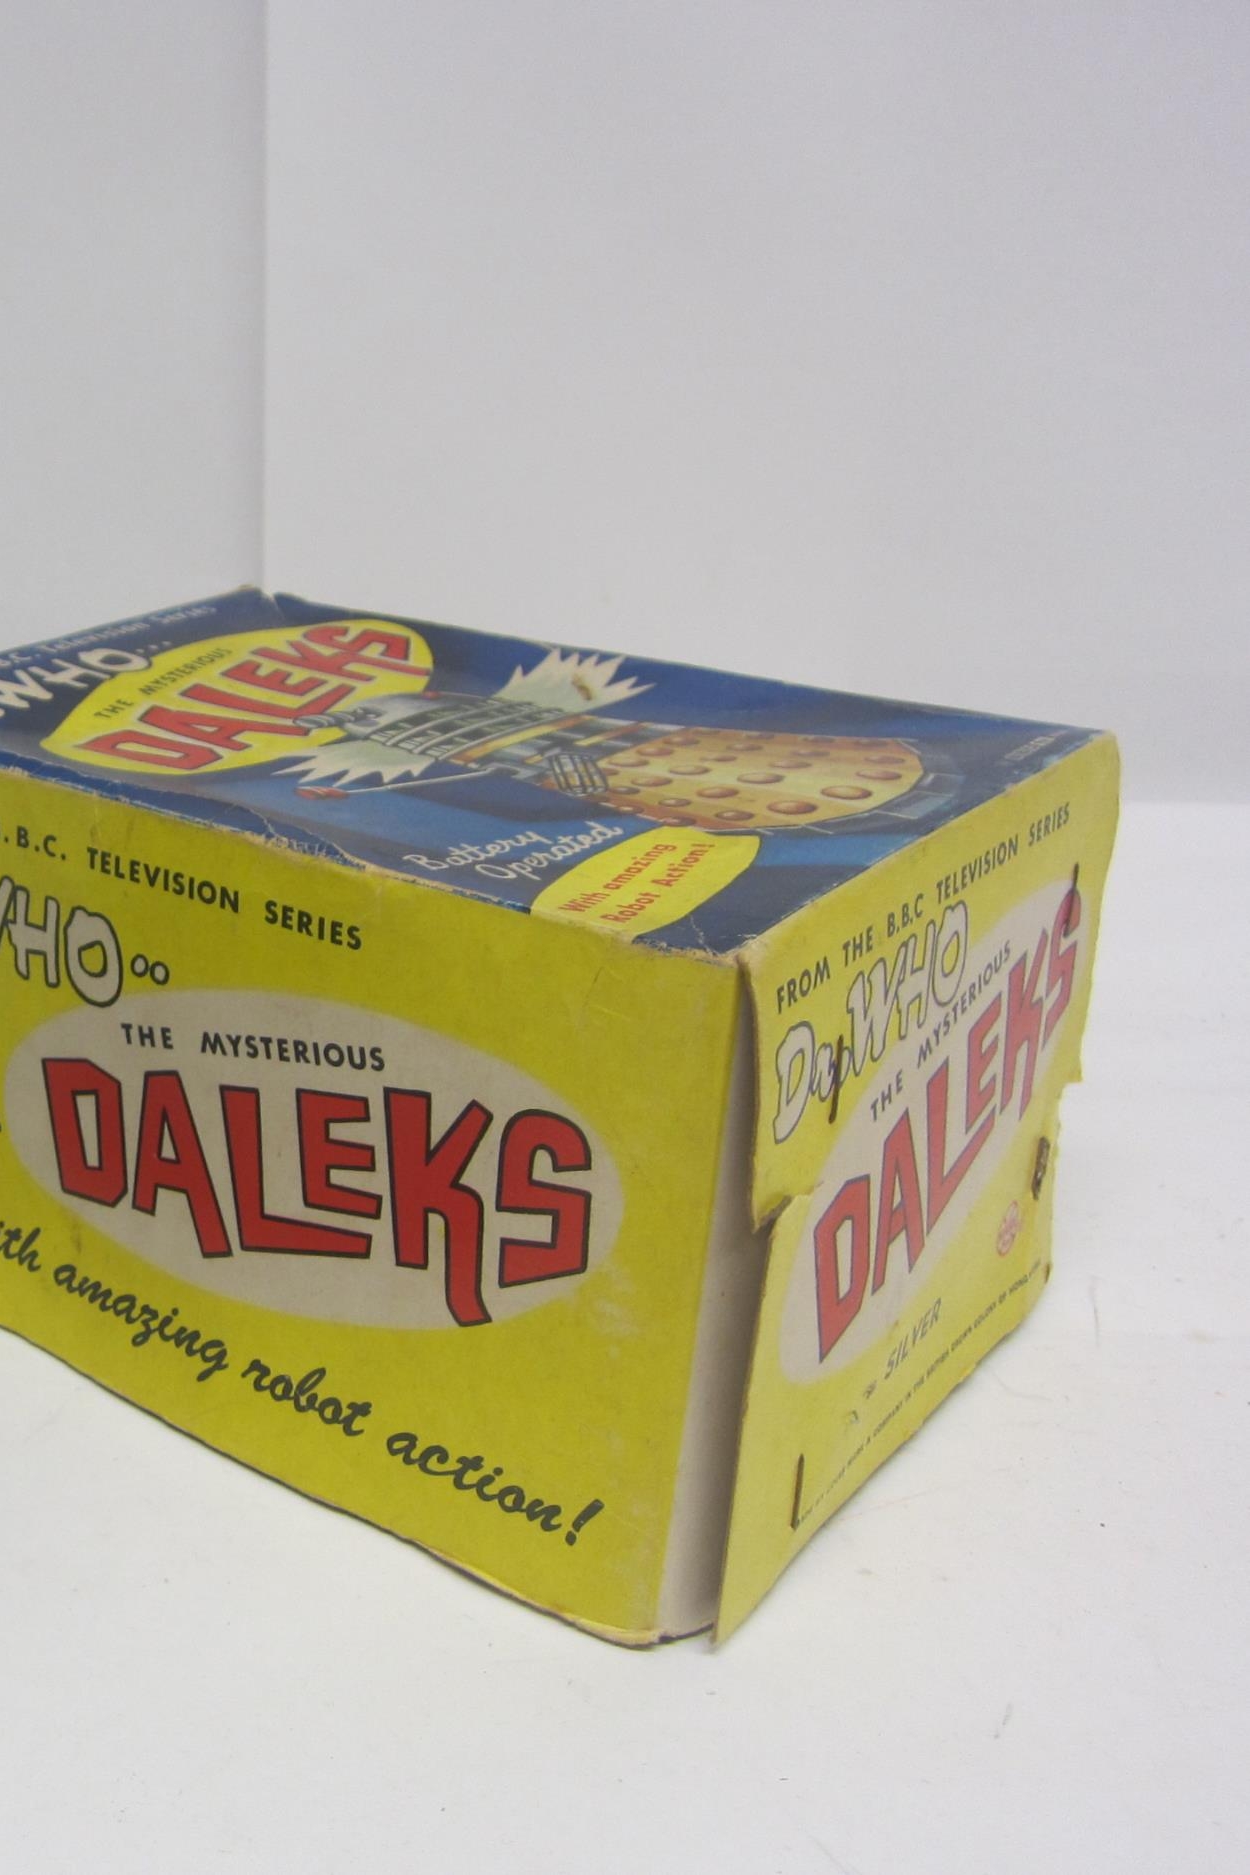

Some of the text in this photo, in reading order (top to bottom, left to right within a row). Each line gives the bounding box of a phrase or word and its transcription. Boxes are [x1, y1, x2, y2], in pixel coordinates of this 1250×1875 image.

[74, 625, 432, 770] DALEKS
[94, 647, 232, 719] THE MYSTERIOUS
[402, 831, 553, 871] Battery
[475, 820, 624, 881] Operated
[558, 843, 678, 913] With amazing
[600, 842, 716, 924] Robot Action!
[86, 846, 240, 913] TELEVISION
[264, 900, 362, 951] SERIES
[775, 956, 831, 1014] FROM
[842, 925, 874, 967] THE
[935, 834, 1018, 902] TELEVISION
[1028, 802, 1070, 846] SERIES
[121, 1022, 386, 1072] THE MYSTERIOUS
[869, 940, 1011, 1122] THE MYSTERIOUS
[813, 888, 1082, 1364] DALEKS
[41, 1057, 592, 1328] DALEKS
[883, 1296, 942, 1381] SILVER
[52, 1262, 230, 1382] amazing
[241, 1357, 373, 1437] robot
[386, 1430, 605, 1547] action!
